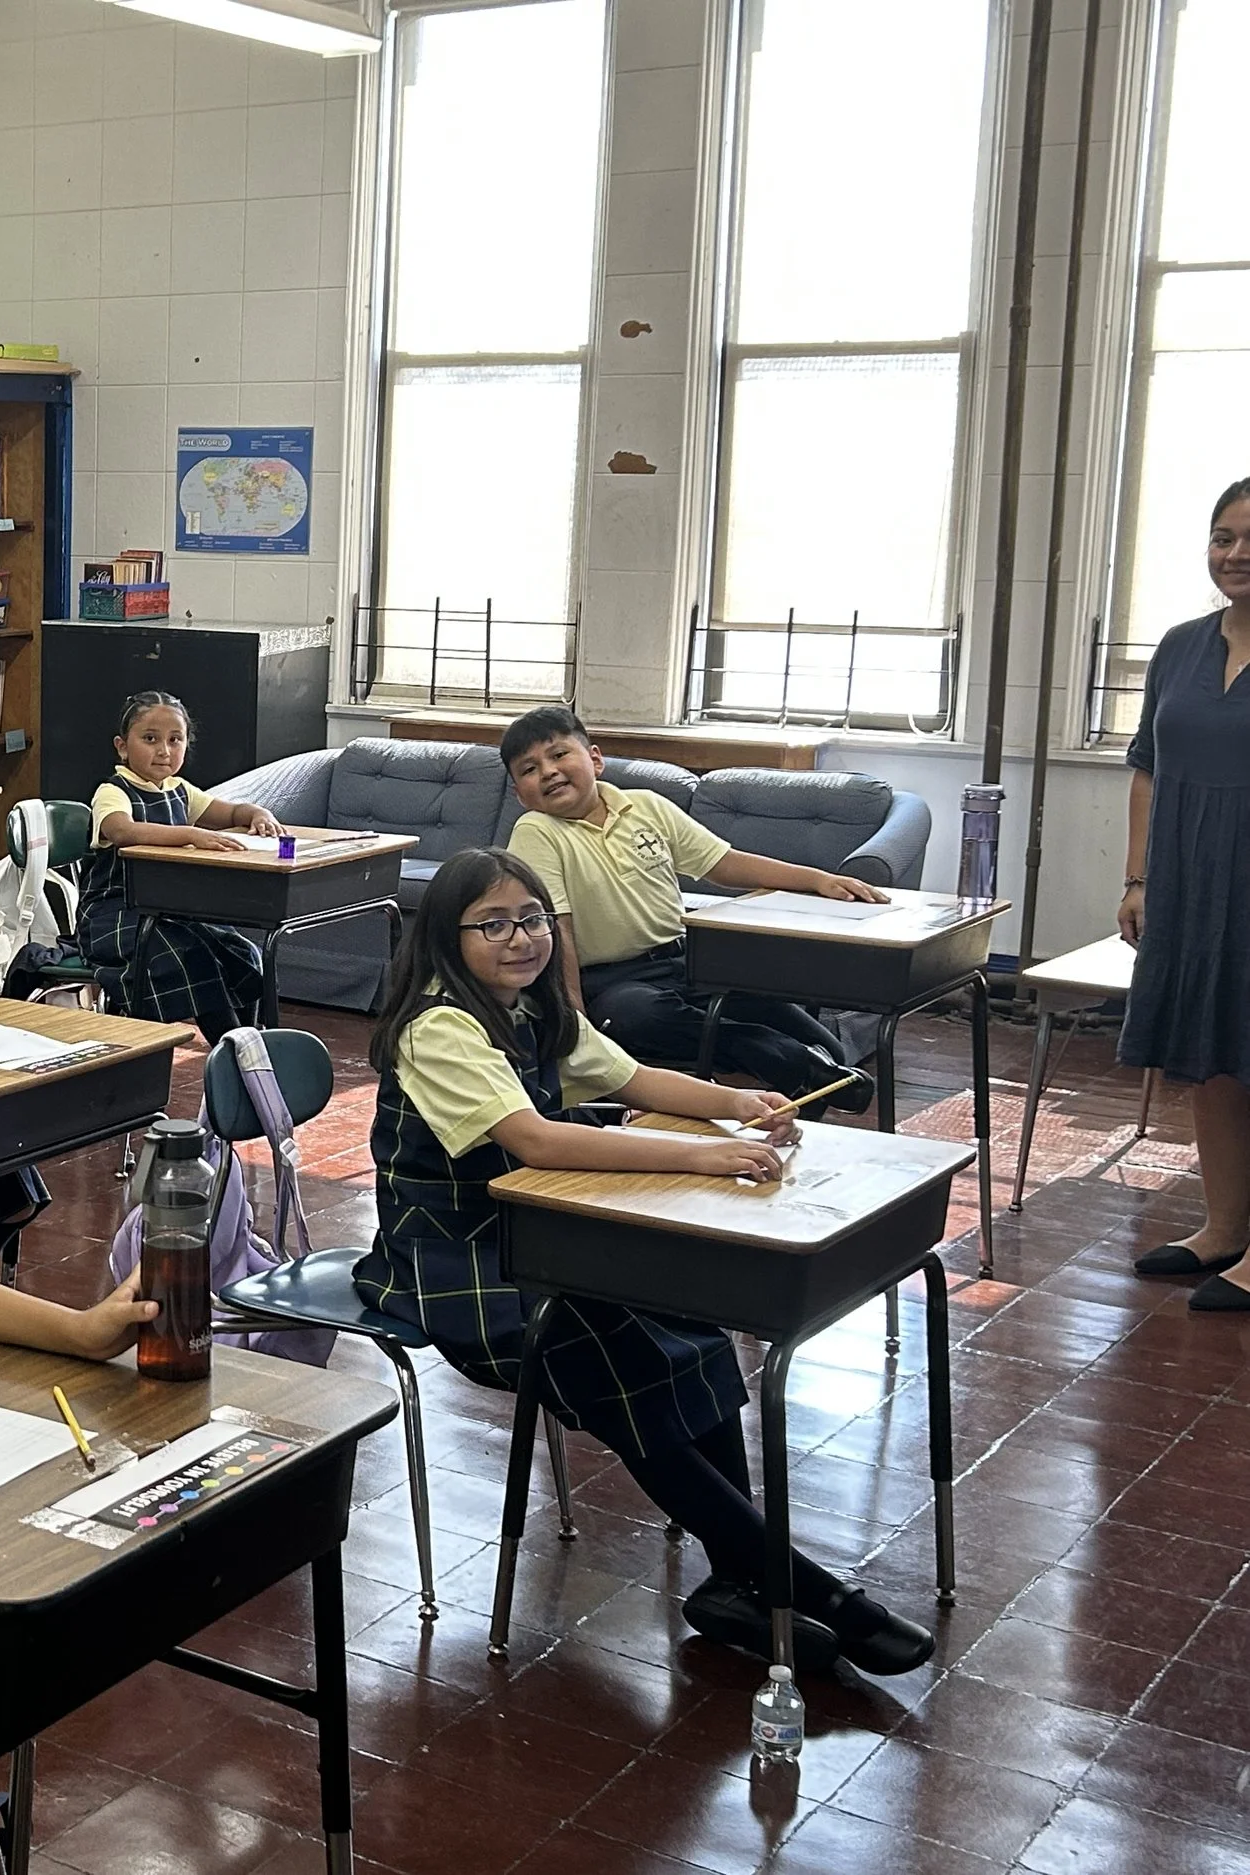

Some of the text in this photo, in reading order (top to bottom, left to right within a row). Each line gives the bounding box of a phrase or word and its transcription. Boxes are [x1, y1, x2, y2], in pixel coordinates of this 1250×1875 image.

[179, 438, 229, 447] THE WORLD
[209, 1438, 260, 1468] BELIEVE
[183, 1463, 211, 1479] IN
[112, 1475, 194, 1518] YOURSELF!
